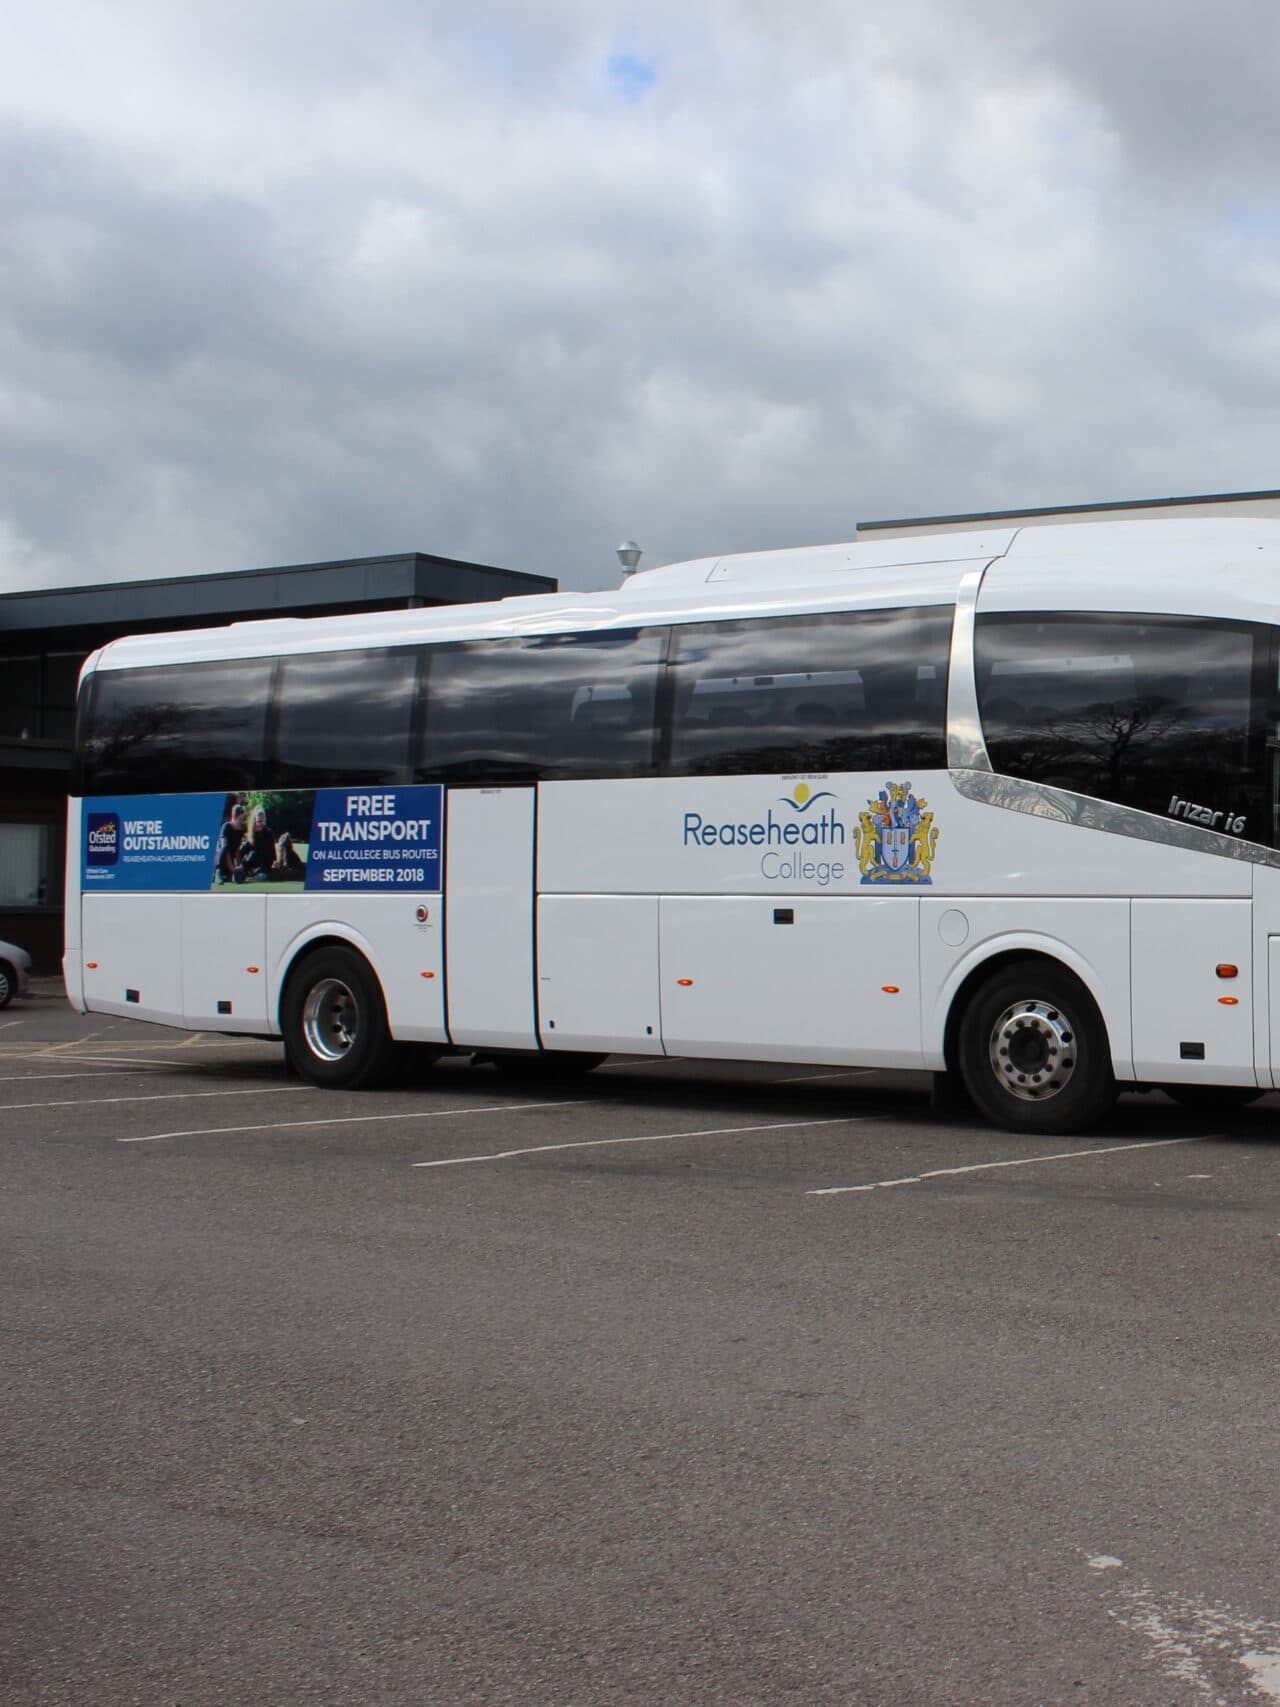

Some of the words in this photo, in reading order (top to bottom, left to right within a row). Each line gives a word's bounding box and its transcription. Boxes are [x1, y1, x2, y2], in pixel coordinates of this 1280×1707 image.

[347, 795, 396, 816] FREE
[1168, 795, 1224, 826] Irizar
[1224, 812, 1247, 833] i6
[123, 821, 163, 835] WE'RE
[318, 820, 432, 842] TRANSPORT
[684, 808, 845, 846] Reaseheath
[88, 830, 117, 844] Ofsted
[123, 835, 210, 851] OUTSTANDING
[312, 850, 327, 860] ON
[327, 850, 342, 860] ALL
[343, 850, 381, 860] COLLEGE
[382, 849, 401, 859] BUS
[402, 849, 439, 859] ROUTES
[323, 868, 395, 882] SEPTEMBER
[396, 868, 425, 882] 2018
[760, 851, 845, 886] College
